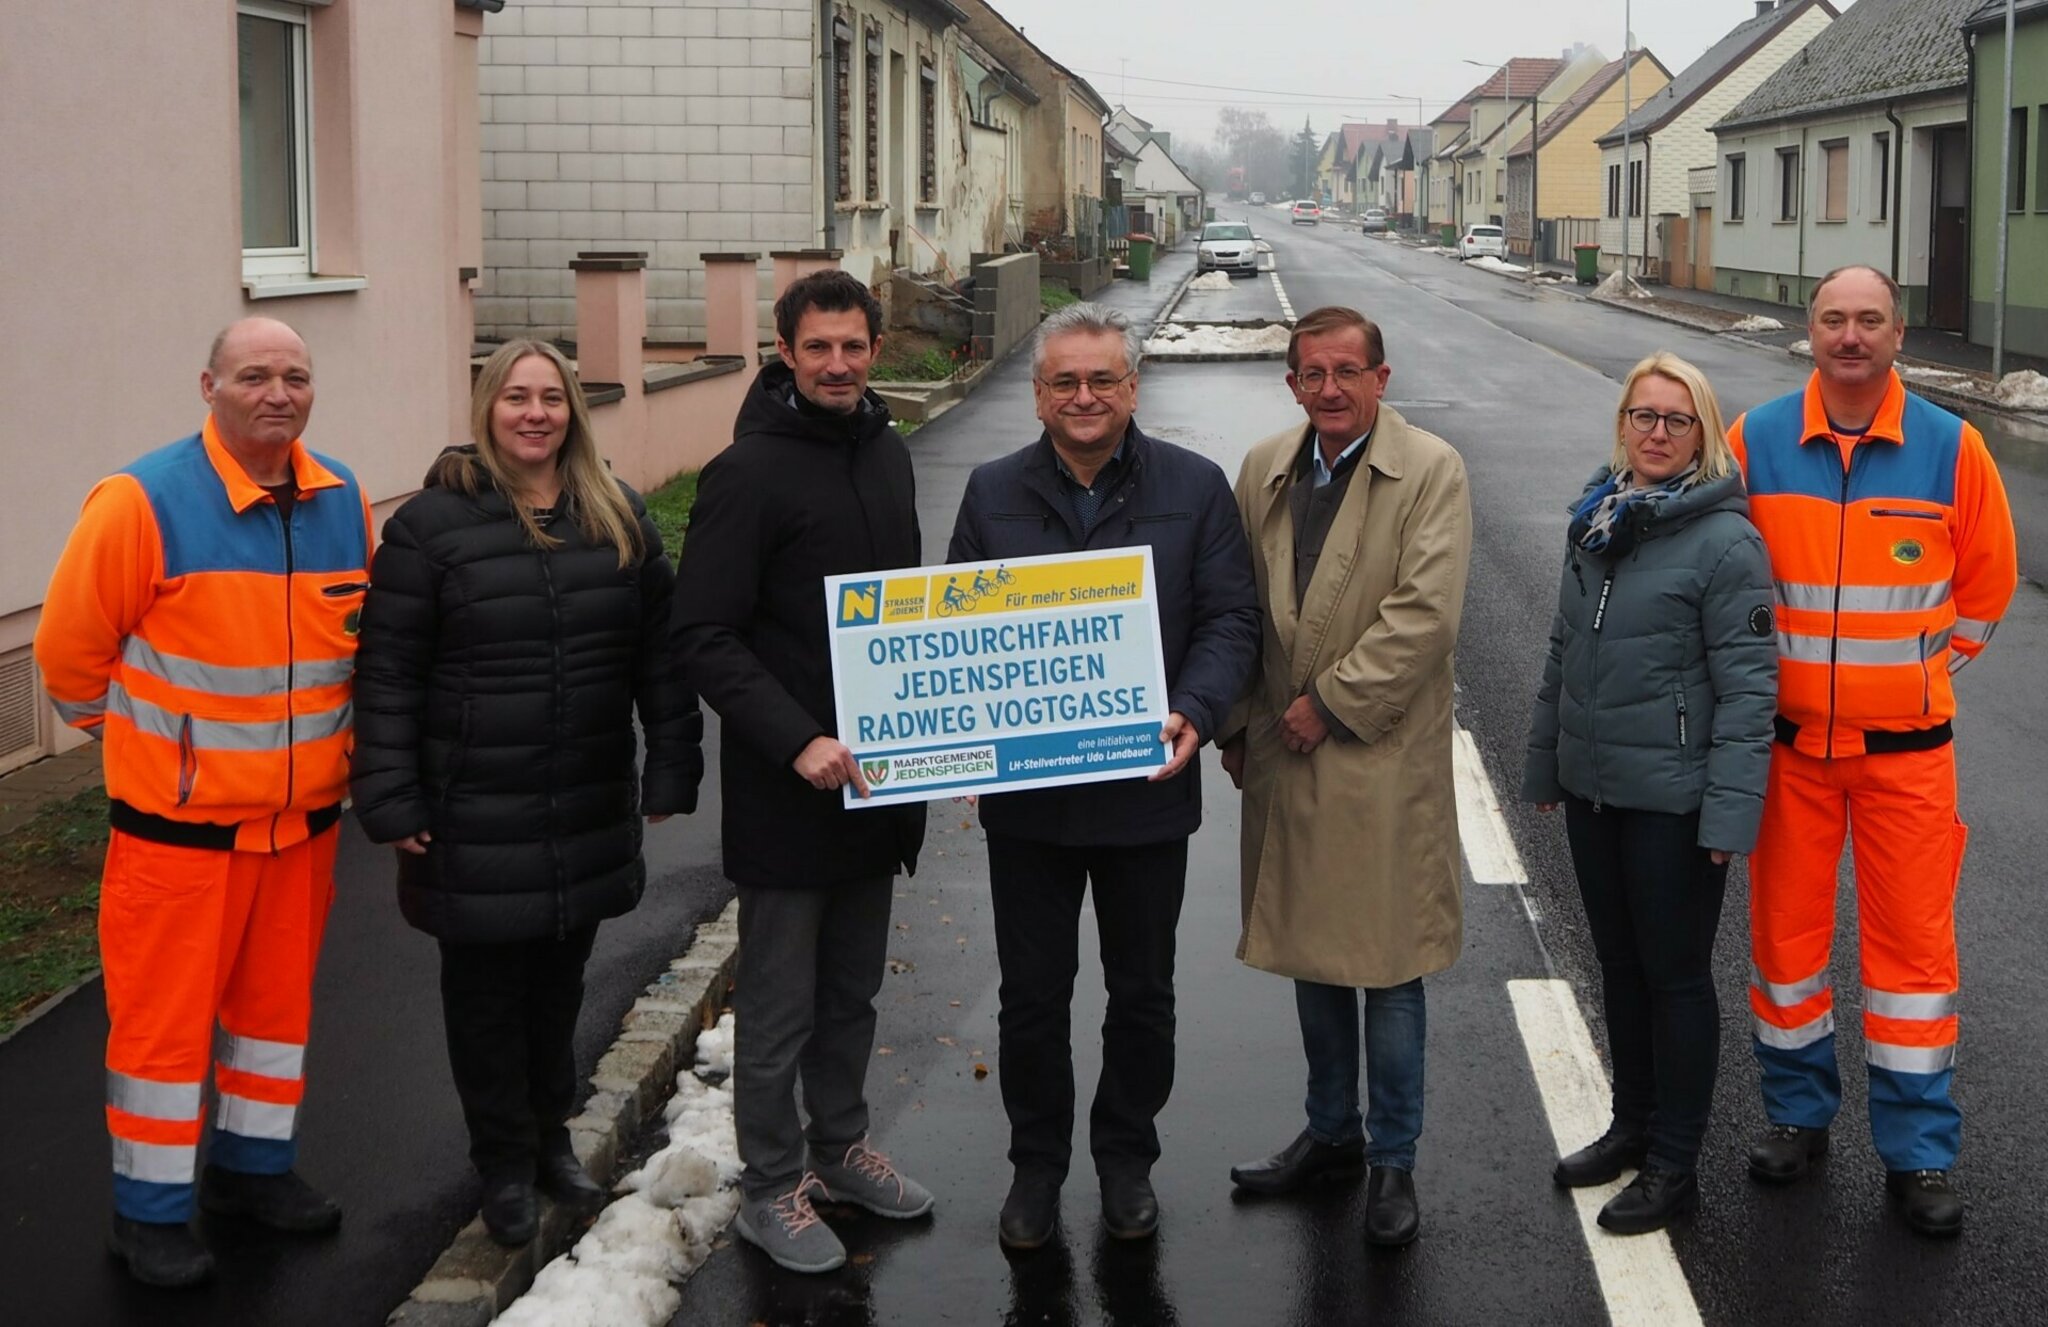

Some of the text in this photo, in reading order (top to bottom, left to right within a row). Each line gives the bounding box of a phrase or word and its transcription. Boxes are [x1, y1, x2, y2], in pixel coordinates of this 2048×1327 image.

[884, 596, 925, 608] STRASSEN
[1005, 582, 1137, 607] Für mehr Sicherheit
[895, 605, 924, 615] DIENST
[867, 613, 1125, 666] ORTSDURCHFAHRT
[894, 653, 1106, 701] JEDENSPEIGEN
[857, 686, 1149, 743] RADWEG VOGTGASSE
[1077, 733, 1152, 750] eine Initiative von
[893, 749, 993, 769] MARKTGEMEINDE
[893, 760, 994, 781] JEDENSPEIGEN
[1008, 747, 1153, 772] LH-Stellvertreter Udo Landbauer
